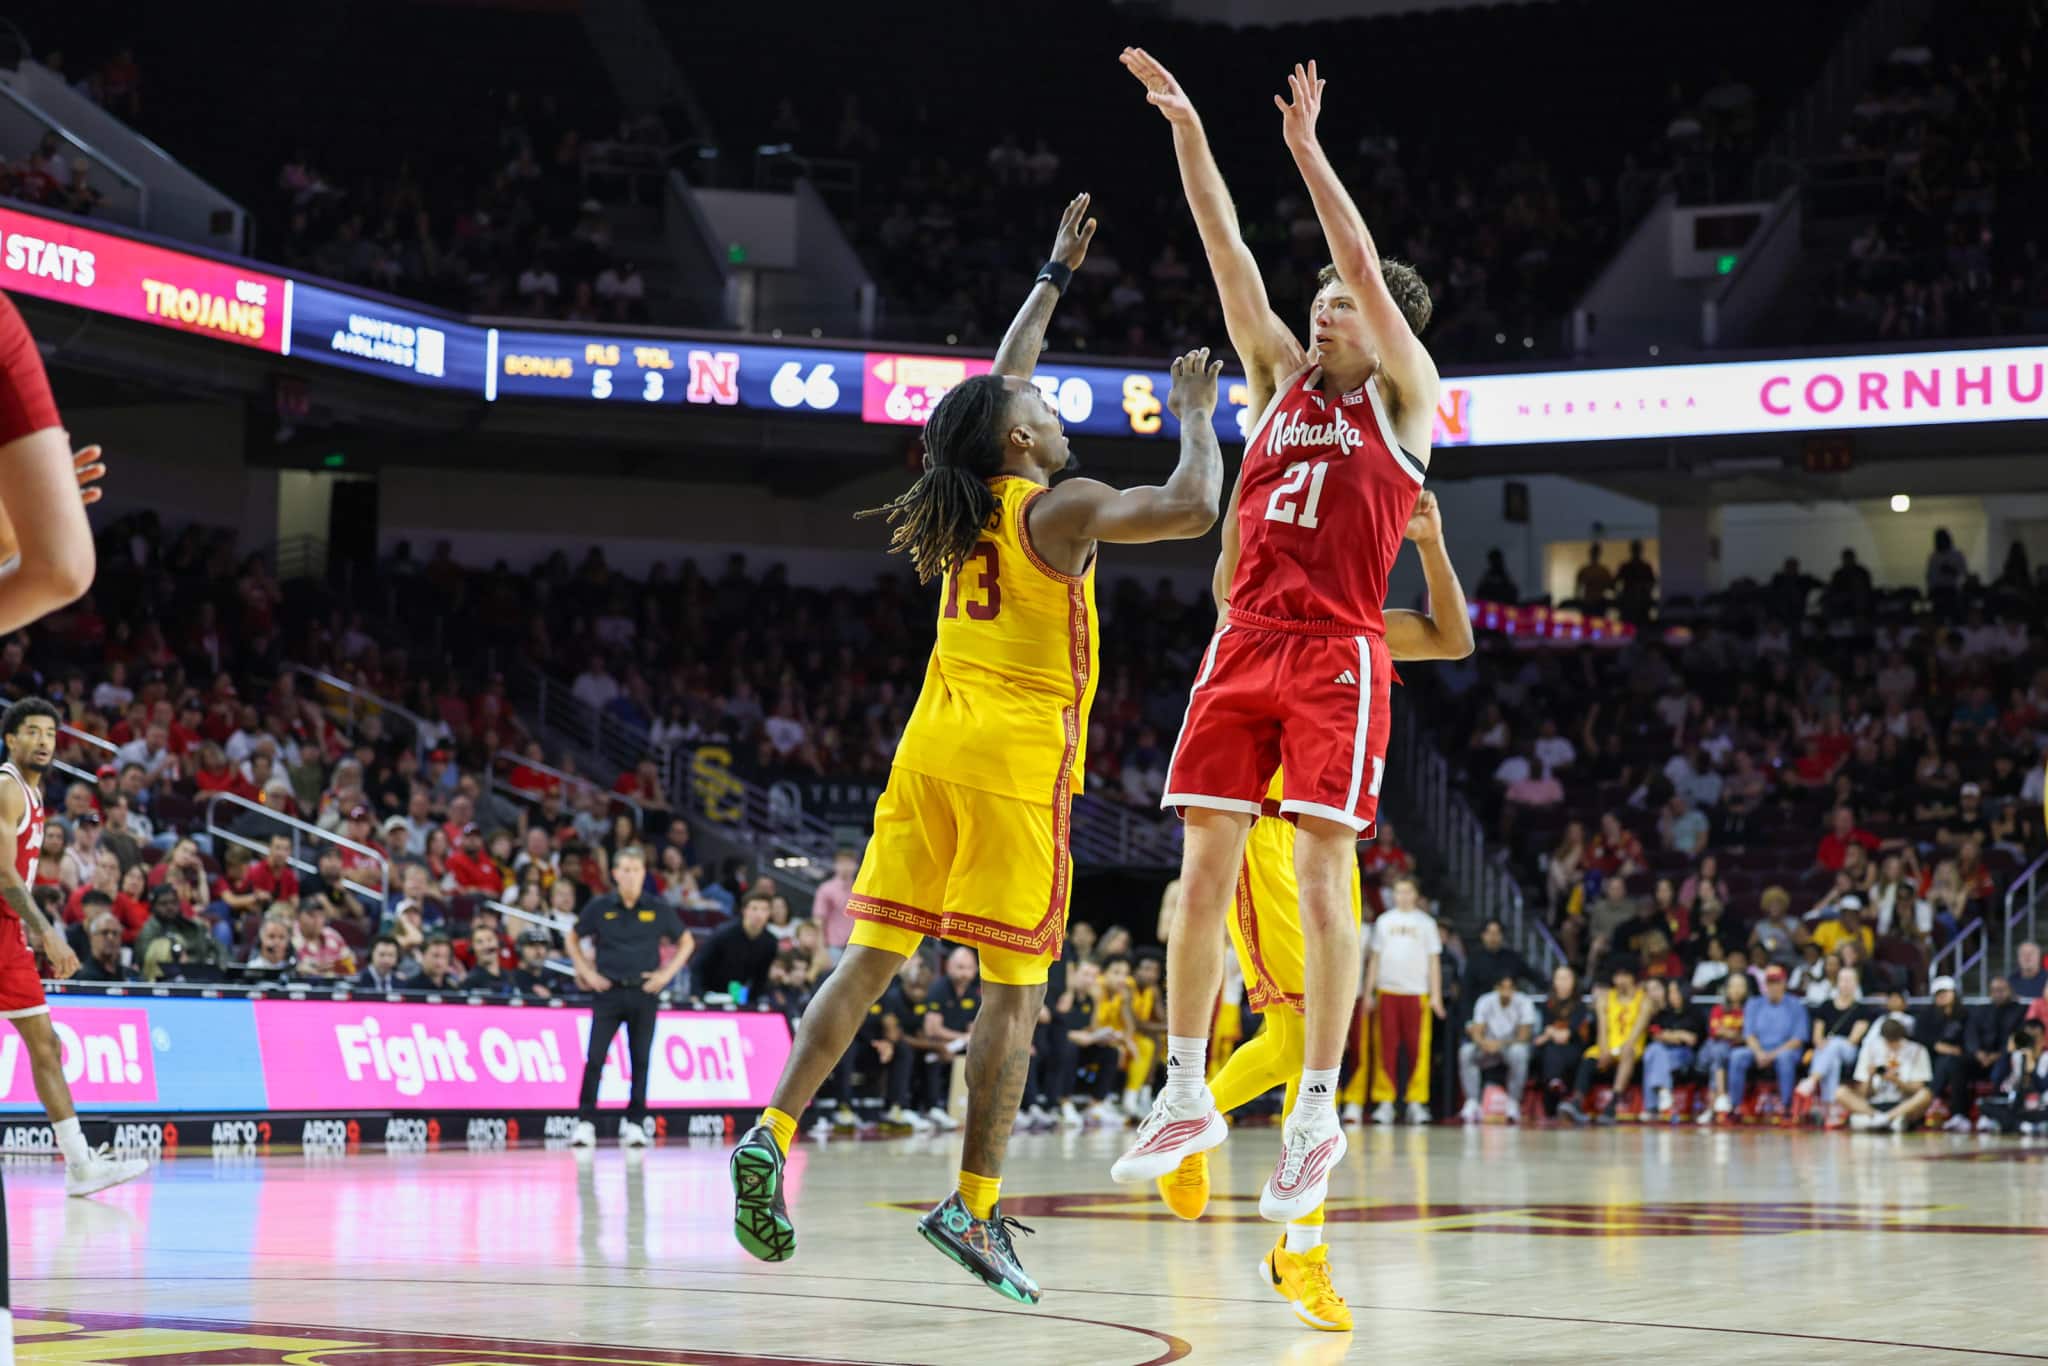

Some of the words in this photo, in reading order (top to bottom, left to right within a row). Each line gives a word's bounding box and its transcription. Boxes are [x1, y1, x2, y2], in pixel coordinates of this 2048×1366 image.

[6, 233, 96, 287] STATS
[142, 279, 266, 340] TROJANS
[349, 313, 416, 347] UNITED
[331, 330, 415, 367] AIRLINES
[585, 344, 620, 366] FLS
[634, 347, 675, 370] TOL
[504, 355, 574, 379] BONUS
[688, 350, 740, 405] N
[592, 369, 614, 399] 5
[642, 371, 664, 401] 3
[770, 362, 840, 409] 66
[1759, 363, 2044, 416] CORNHU
[1517, 396, 1696, 417] NEBRASKA
[1266, 407, 1363, 457] Nebraska
[1264, 461, 1329, 529] 21
[943, 541, 1002, 621] 13
[335, 1017, 478, 1096] Fight
[479, 1026, 568, 1084] On!
[664, 1034, 735, 1082] On!
[3, 1127, 53, 1148] ARCO
[114, 1122, 163, 1146] ARCO
[212, 1121, 258, 1145] ARCO
[302, 1119, 347, 1143] ARCO
[385, 1118, 428, 1142] ARCO
[466, 1117, 508, 1140] ARCO
[688, 1114, 726, 1138] ARCO
